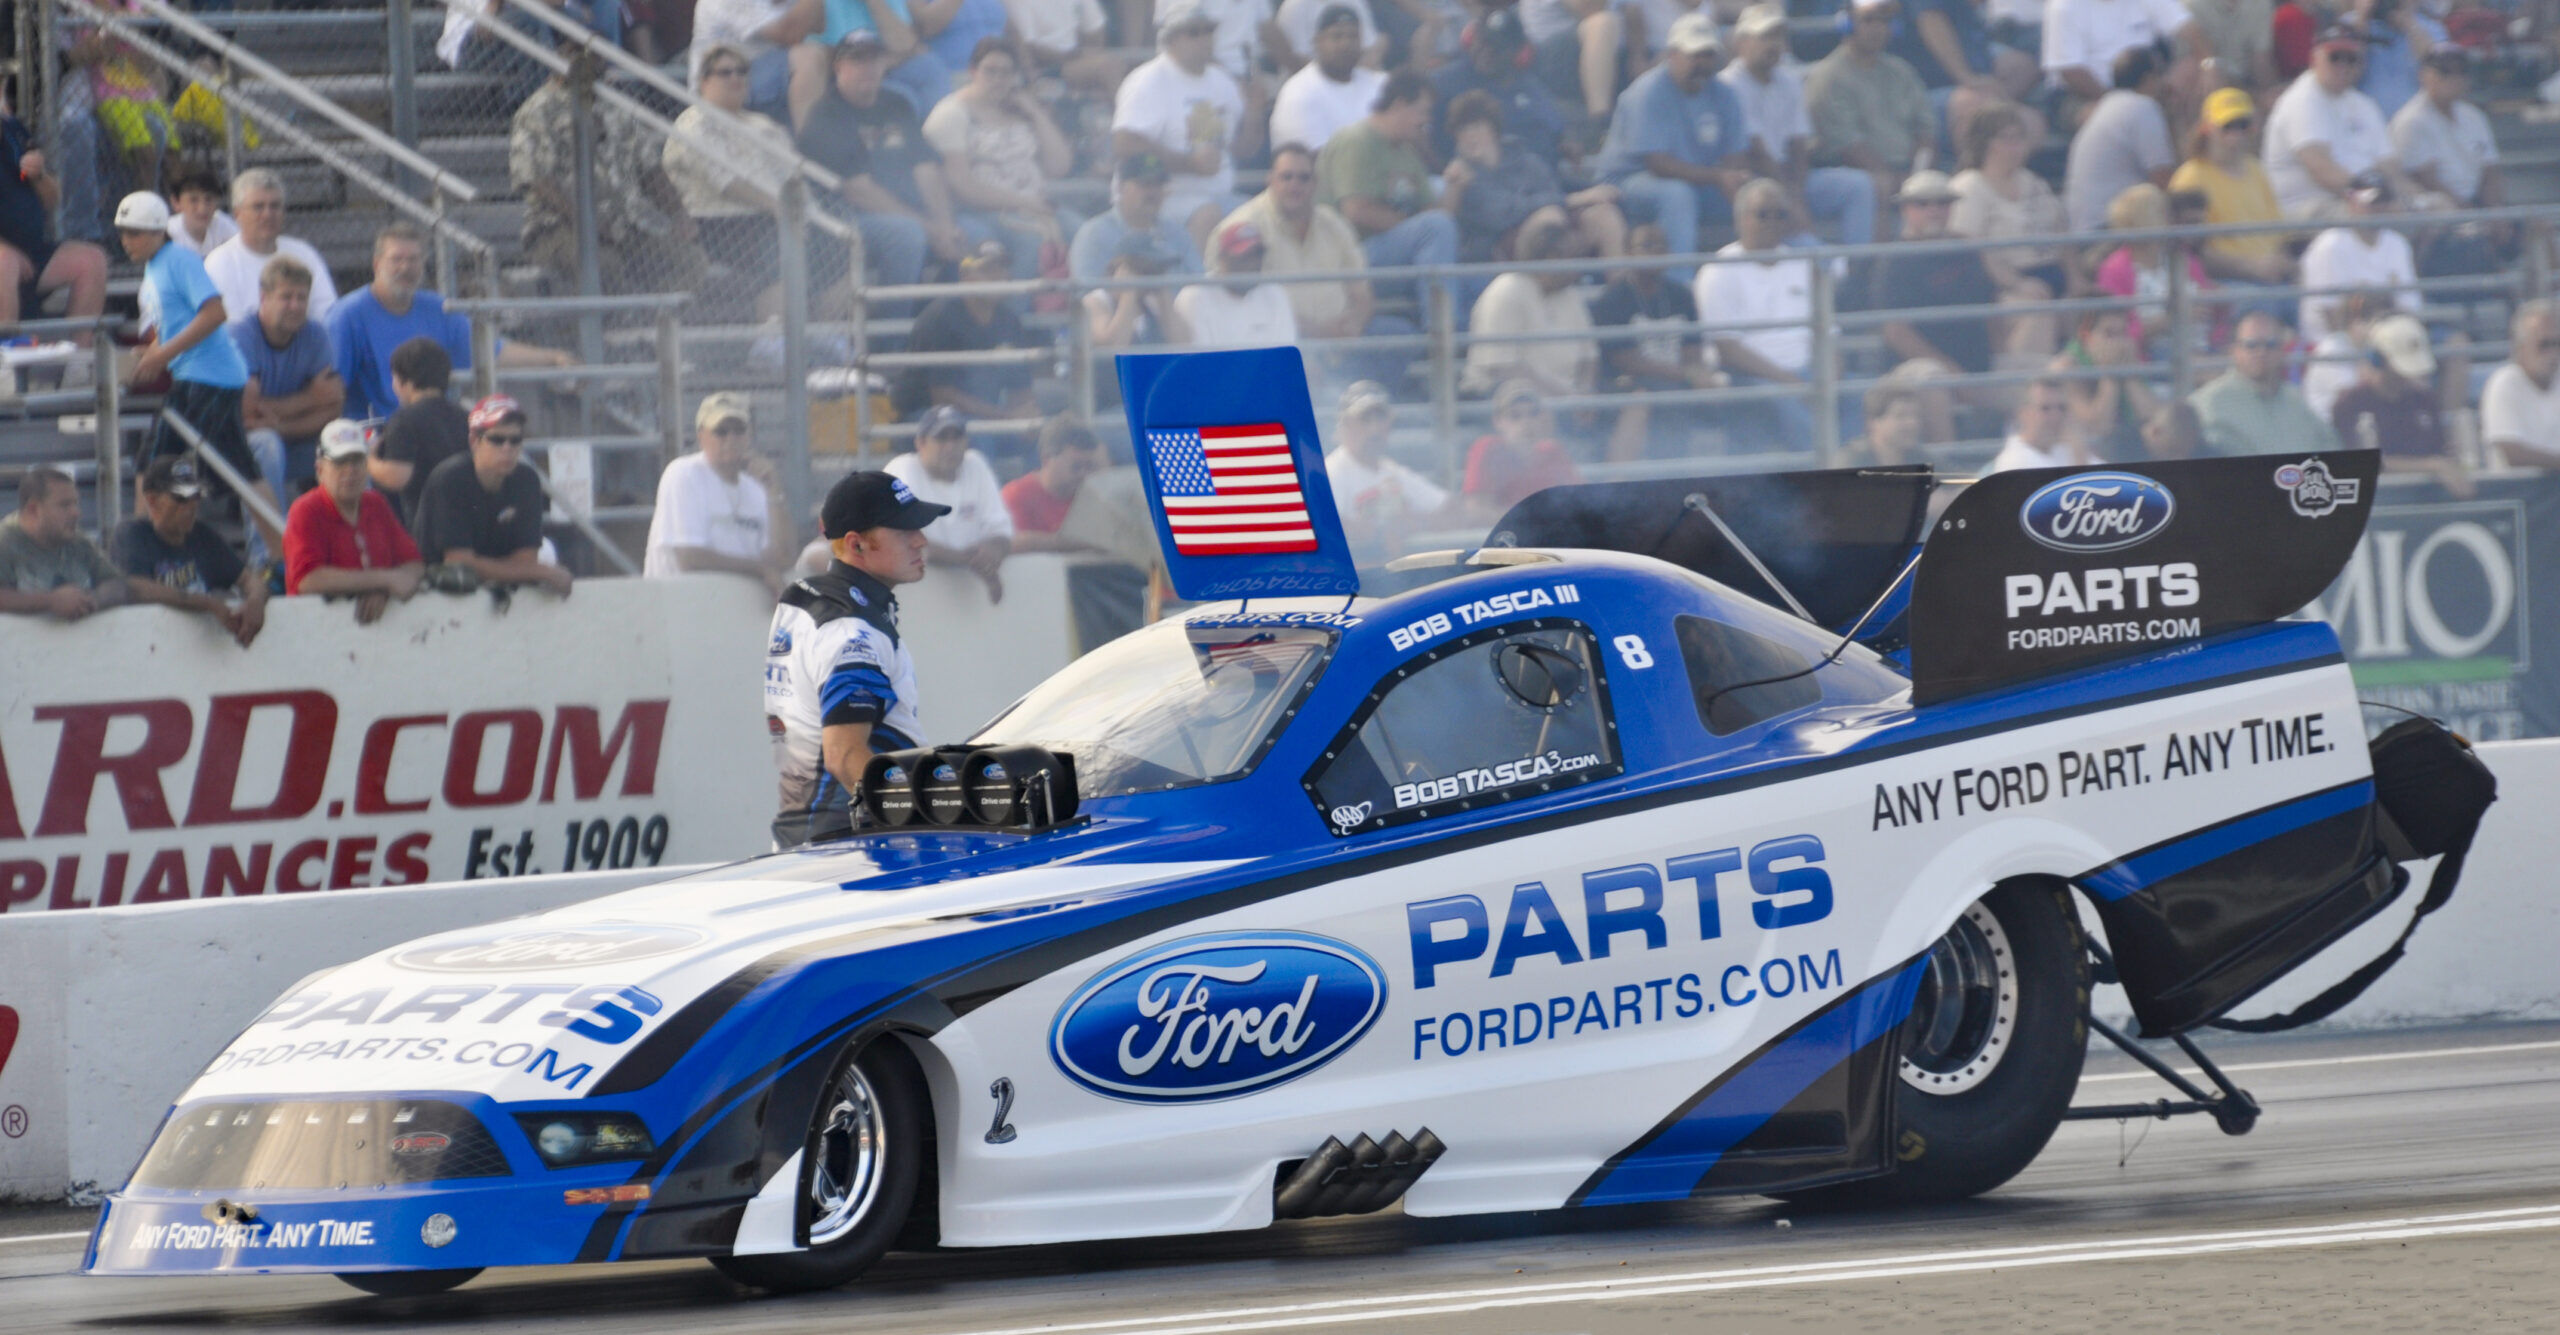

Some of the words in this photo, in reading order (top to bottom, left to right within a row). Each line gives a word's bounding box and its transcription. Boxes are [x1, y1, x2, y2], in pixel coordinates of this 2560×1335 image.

[2052, 485, 2143, 538] Ford
[2005, 562, 2200, 618] PARTS
[1388, 612, 1452, 652] BOB
[1453, 588, 1554, 625] TASCA
[1554, 584, 1580, 604] III
[2008, 617, 2201, 650] FORDPARTS.COM
[1613, 634, 1654, 670] 8
[0, 689, 670, 842] RD.COM
[1872, 778, 1943, 831] ANY
[1953, 761, 2049, 816] FORD
[2058, 744, 2150, 797] PART.
[2163, 718, 2235, 780] ANY
[2241, 713, 2334, 765] TIME.
[882, 801, 899, 809] Drive
[932, 799, 949, 807] Drive
[981, 797, 998, 805] Drive
[463, 825, 542, 880] Est.
[562, 813, 669, 873] 1909
[1406, 834, 1834, 990] PARTS
[433, 930, 660, 965] Ford
[1118, 959, 1319, 1076] Ford
[1413, 948, 1844, 1060] FORDPARTS.COM
[129, 1222, 166, 1250] ANY
[168, 1222, 212, 1249] FORD
[212, 1222, 263, 1249] PART.
[266, 1221, 320, 1248] ANY
[319, 1219, 375, 1246] TIME.
